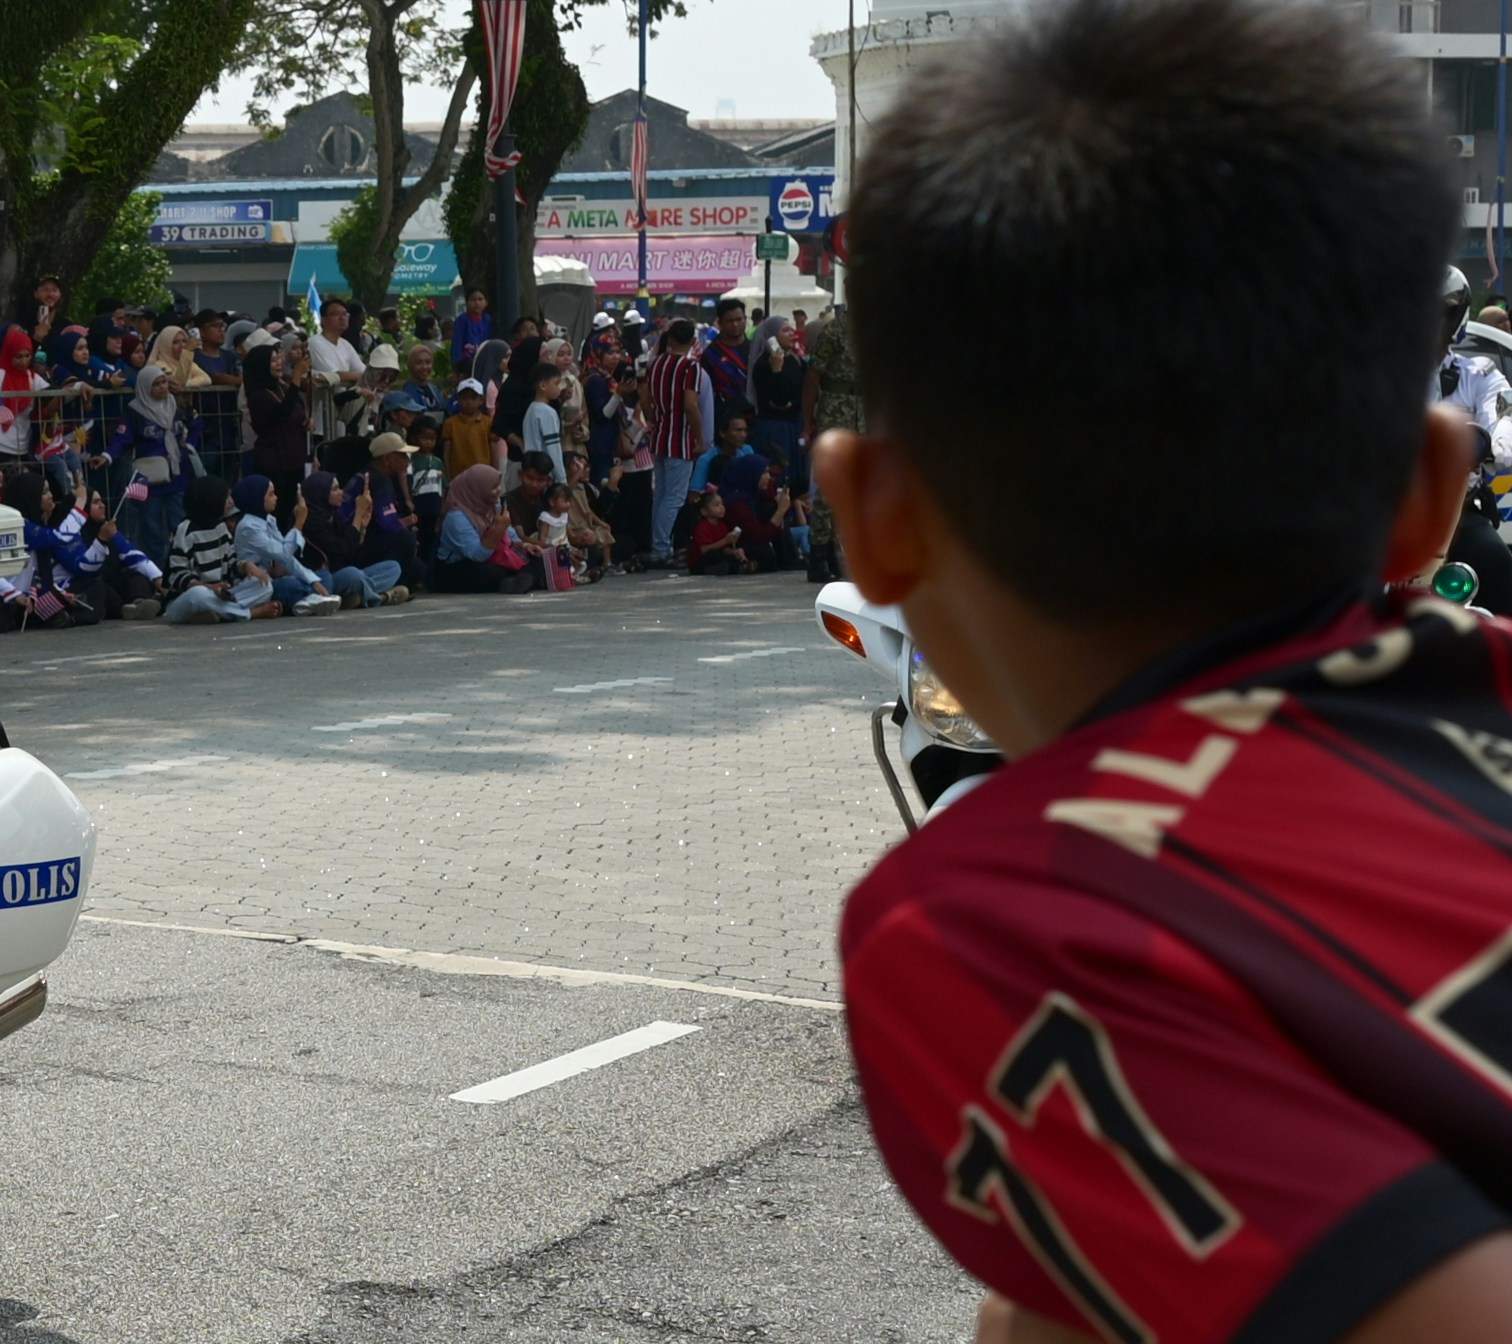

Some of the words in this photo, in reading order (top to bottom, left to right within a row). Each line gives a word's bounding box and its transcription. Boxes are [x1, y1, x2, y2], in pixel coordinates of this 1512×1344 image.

[781, 201, 811, 209] PEPSI
[211, 206, 237, 219] SHOP
[547, 210, 561, 228] A
[567, 209, 618, 228] META
[625, 208, 683, 228] MRE
[690, 206, 748, 226] SHOP
[161, 226, 180, 241] 39
[189, 226, 259, 239] TRADING
